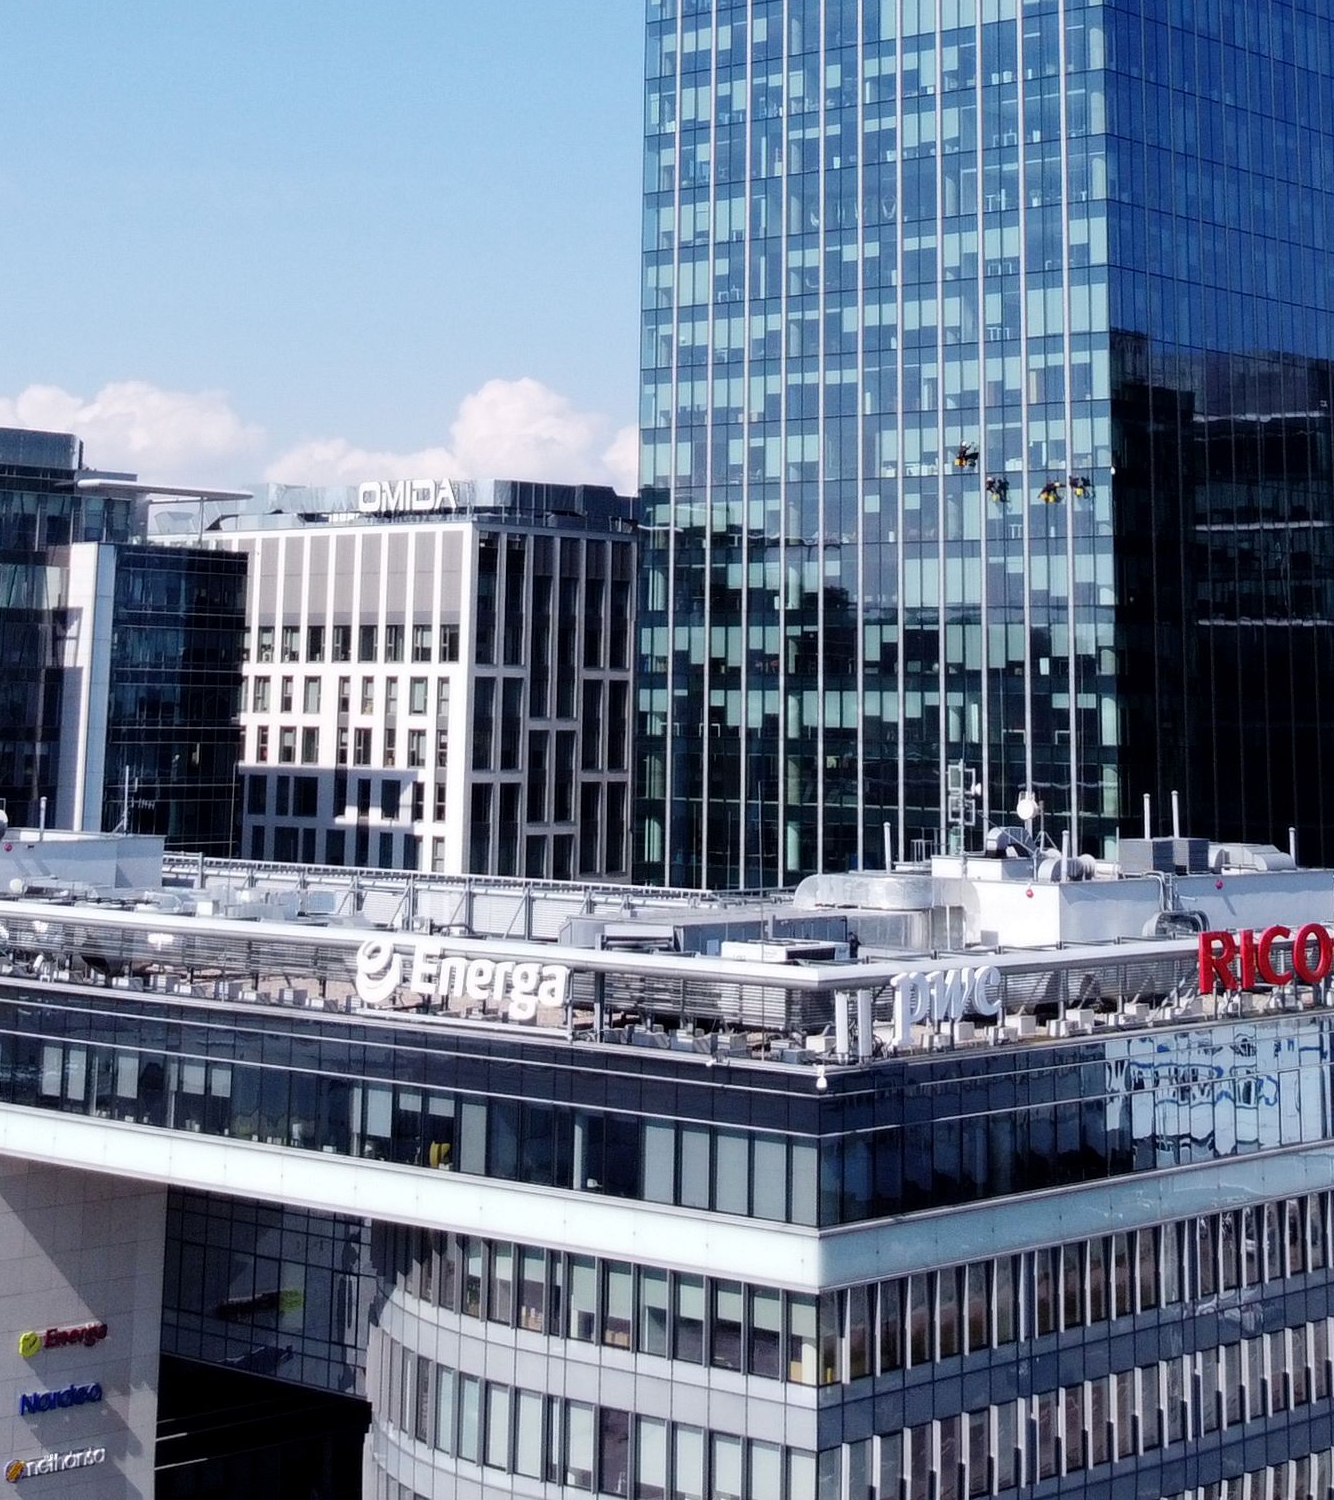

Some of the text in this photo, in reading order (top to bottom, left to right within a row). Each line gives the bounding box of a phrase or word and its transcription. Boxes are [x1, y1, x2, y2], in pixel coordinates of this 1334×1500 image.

[358, 478, 457, 512] OMIDA
[410, 943, 570, 1021] Energa
[890, 965, 1002, 1047] pwc
[43, 1323, 108, 1347] Energa
[20, 1383, 103, 1416] Nordea
